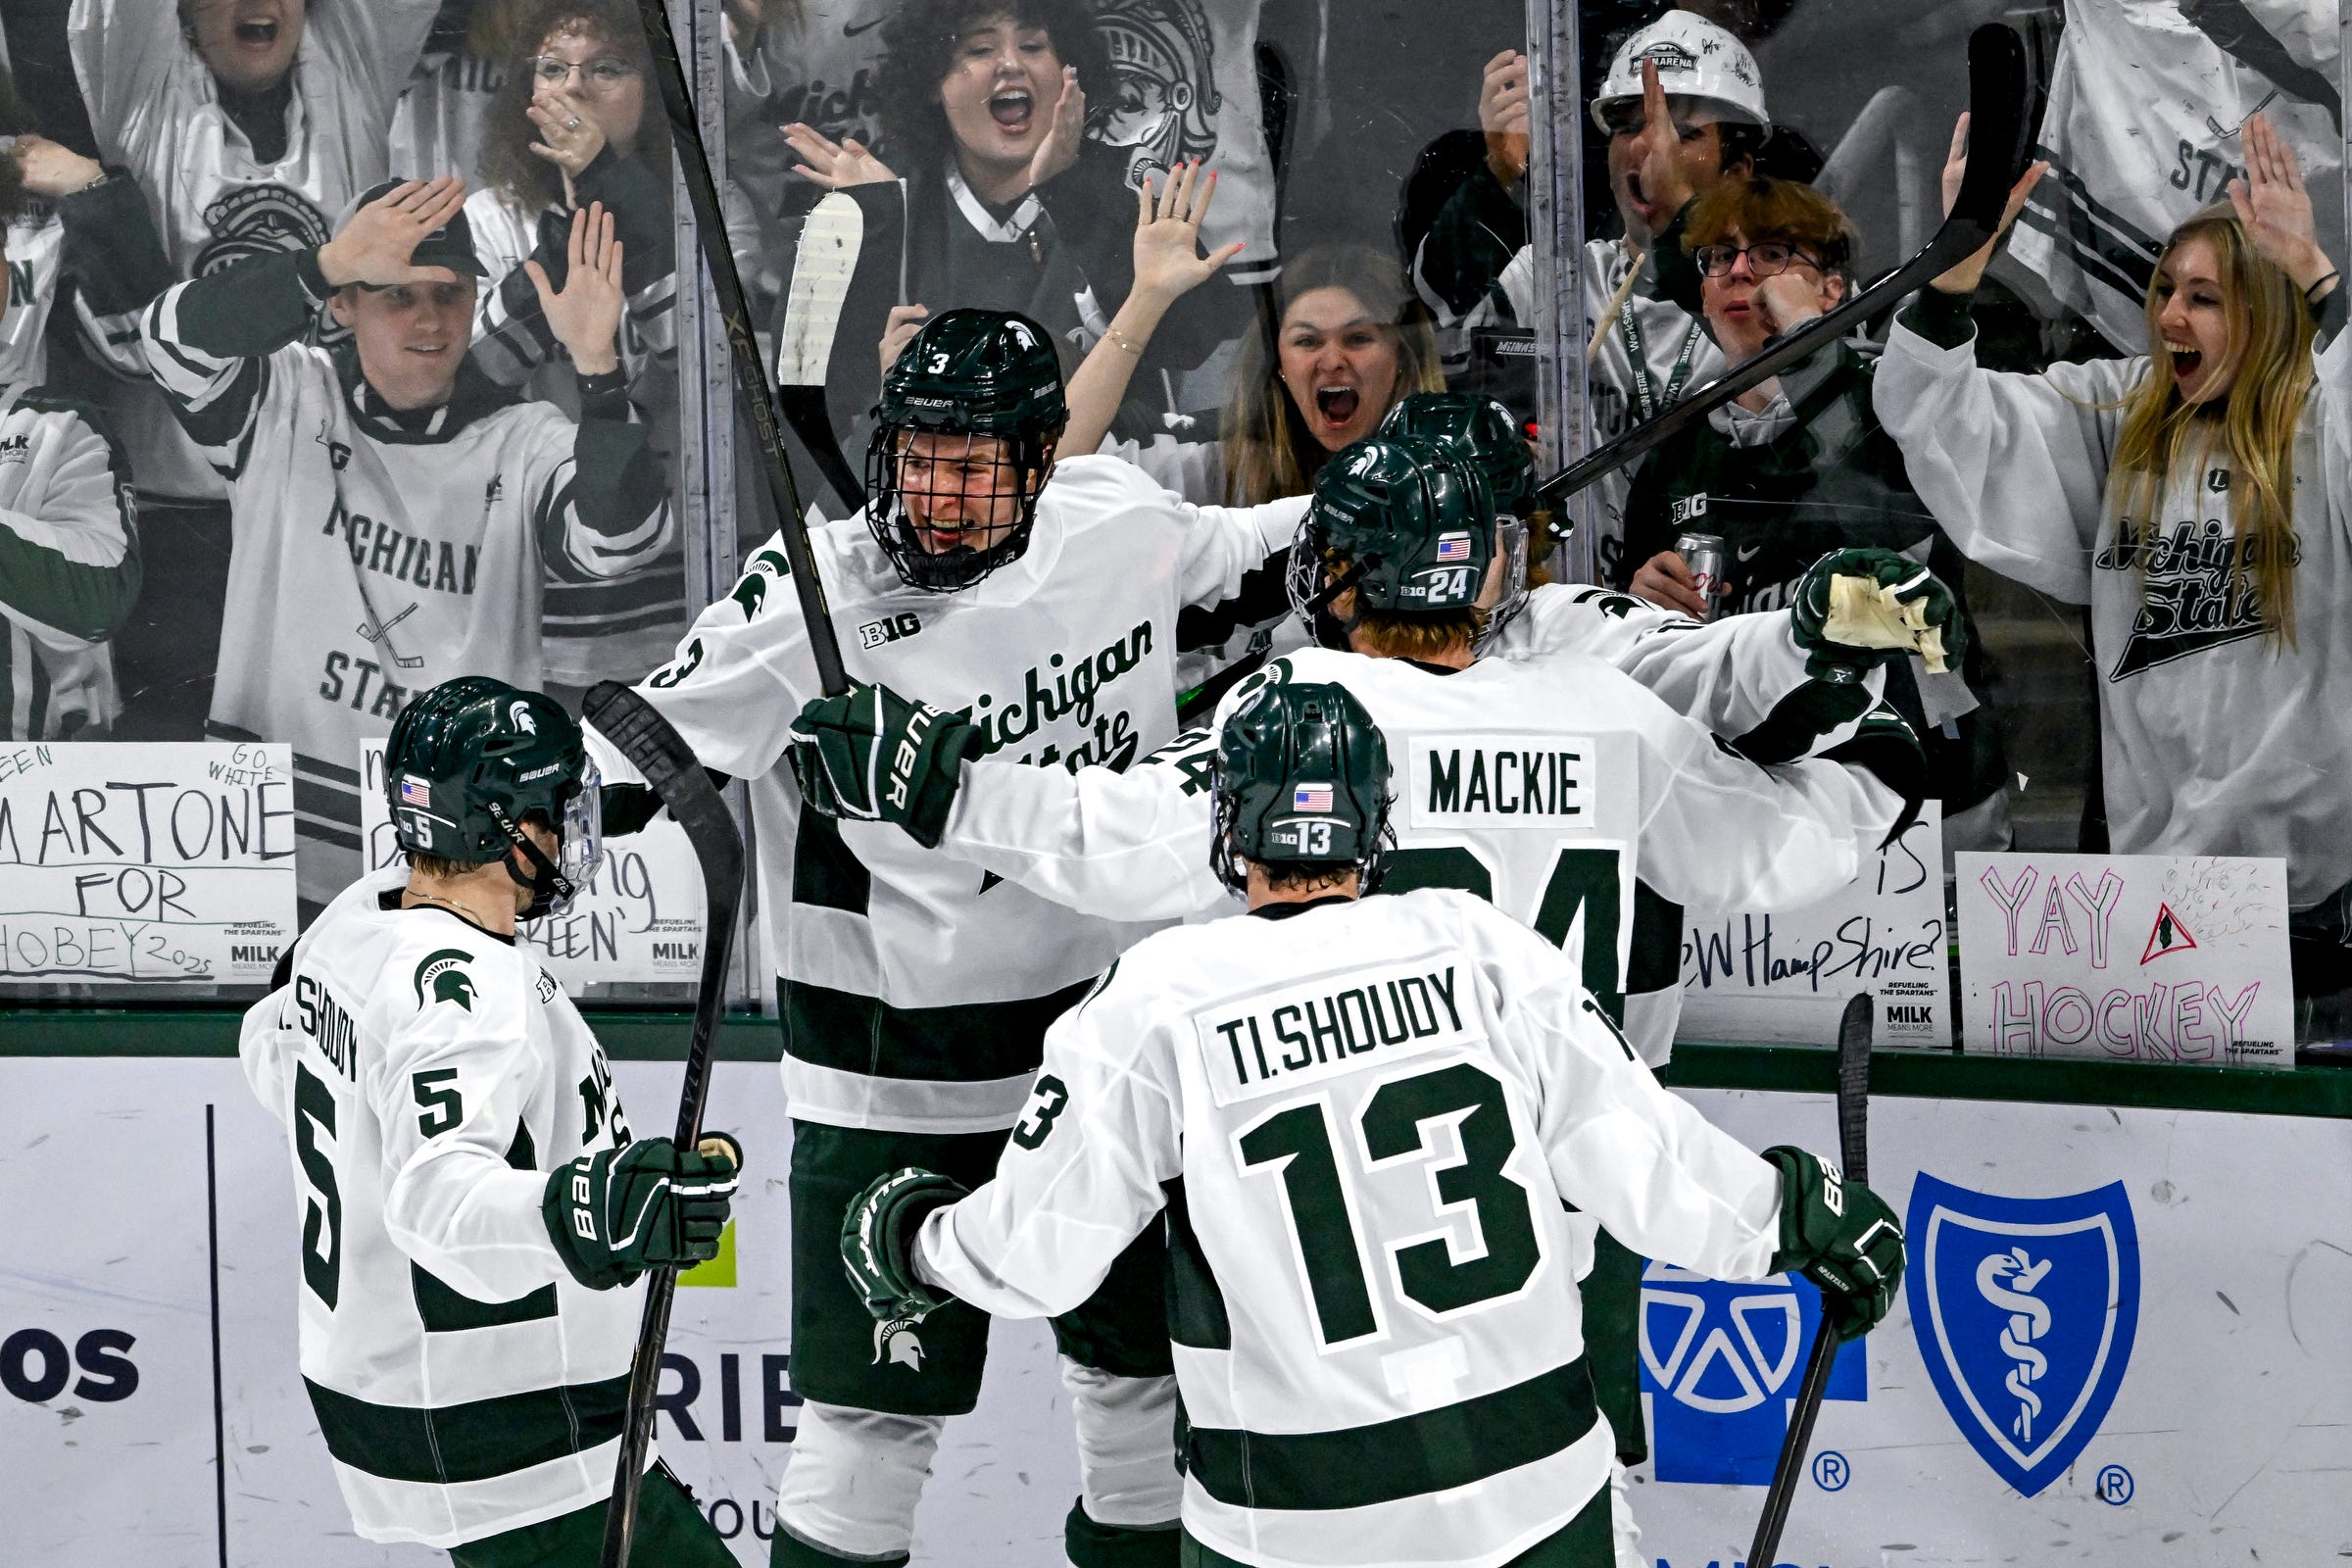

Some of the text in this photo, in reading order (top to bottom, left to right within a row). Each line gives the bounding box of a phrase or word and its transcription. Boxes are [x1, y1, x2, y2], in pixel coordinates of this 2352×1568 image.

[1633, 57, 1692, 70] MN ARENA
[927, 353, 951, 374] 3
[742, 364, 781, 460] GHOST
[905, 395, 954, 408] BAUER
[1427, 568, 1469, 604] 24
[319, 650, 424, 721] STA
[955, 619, 1153, 756] ichigan
[0, 745, 53, 783] EEN
[208, 760, 274, 786] WHITE
[232, 744, 267, 769] GO
[518, 762, 560, 783] BAUER
[885, 705, 942, 811] AUER
[1428, 749, 1582, 815] MACKIE
[415, 814, 433, 851] 5
[1295, 821, 1332, 856] 13
[74, 867, 197, 922] FOR
[1980, 864, 2125, 969] YAY
[146, 935, 213, 974] 2025
[231, 946, 279, 962] MILK
[652, 943, 700, 959] MILK
[1886, 1005, 1933, 1024] MILK
[1990, 980, 2261, 1065] HOCKEY
[412, 1067, 465, 1140] 5
[294, 1059, 343, 1313] 5
[1239, 1061, 1544, 1347] 13
[1816, 1264, 1851, 1293] SPARTANS
